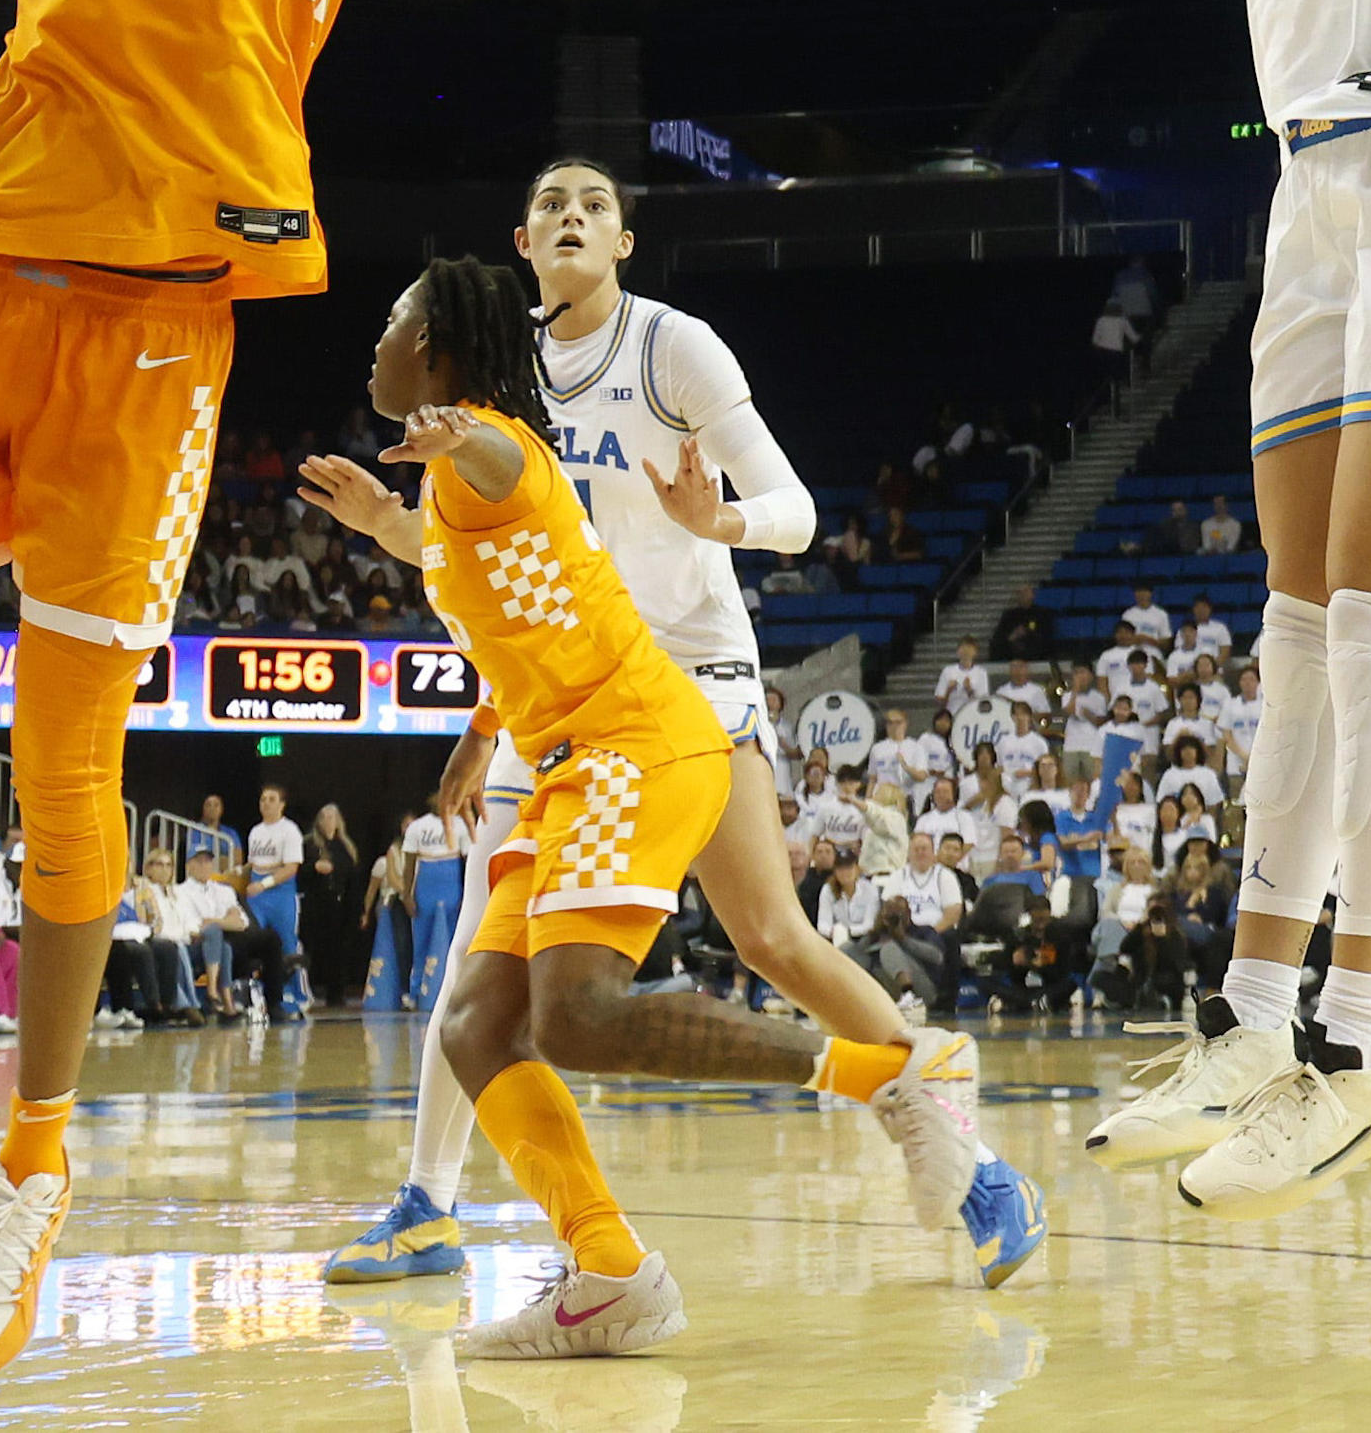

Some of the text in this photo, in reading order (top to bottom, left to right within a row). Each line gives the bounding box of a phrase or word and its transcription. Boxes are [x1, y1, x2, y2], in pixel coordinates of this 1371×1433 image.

[1230, 123, 1265, 139] EXT
[283, 217, 299, 231] 48
[238, 649, 335, 692] 1:56
[410, 653, 466, 692] 72
[225, 698, 346, 720] 4TH Quarter
[808, 717, 861, 749] Ucla
[960, 720, 1002, 749] Ucl
